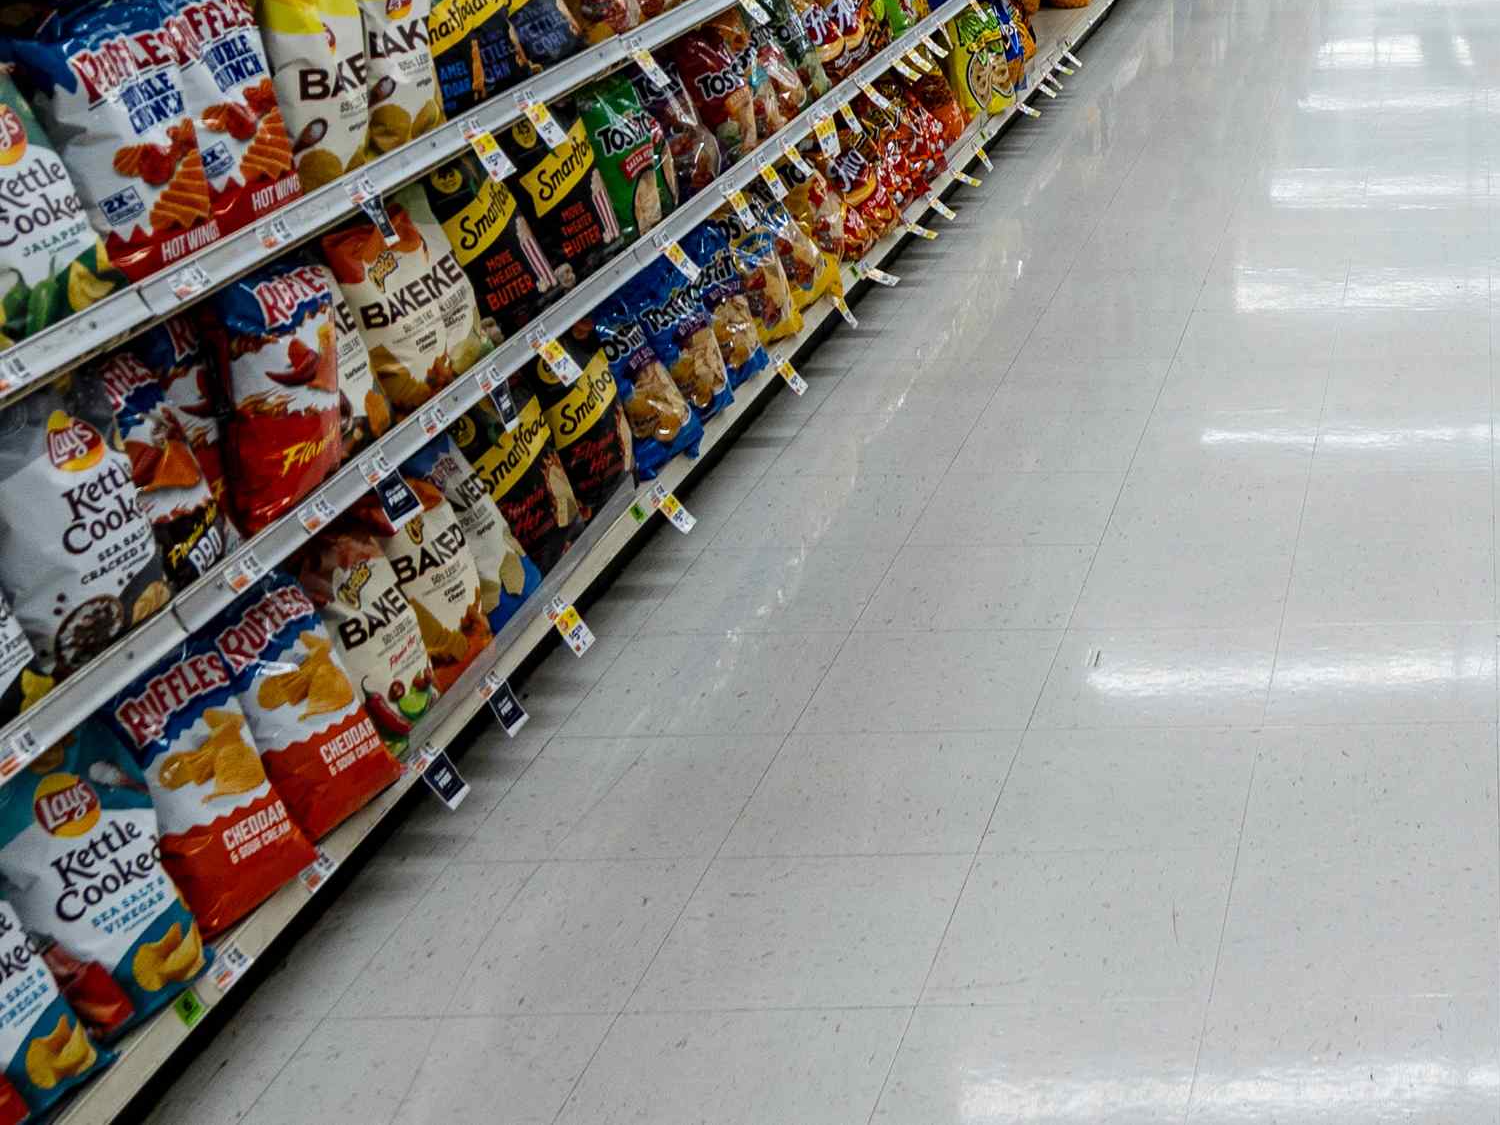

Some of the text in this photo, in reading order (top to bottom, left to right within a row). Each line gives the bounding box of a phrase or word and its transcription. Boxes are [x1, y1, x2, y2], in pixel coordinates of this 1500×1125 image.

[299, 56, 369, 102] BAKE
[103, 196, 129, 217] 2X
[252, 189, 274, 211] HOT
[161, 238, 188, 262] HOT
[485, 276, 536, 312] BUTTER
[61, 458, 131, 523] Kettl
[80, 547, 136, 587] CRACKED
[218, 585, 315, 673] RUFFLES
[115, 652, 231, 749] RUFFLES
[318, 715, 376, 765] CHEDDAR
[222, 799, 288, 850] CHEDDAR
[51, 819, 143, 891] Kettle
[55, 839, 164, 923] Cooked
[91, 906, 121, 928] SEA
[120, 883, 156, 909] SALT
[103, 891, 167, 935] VINEGAR
